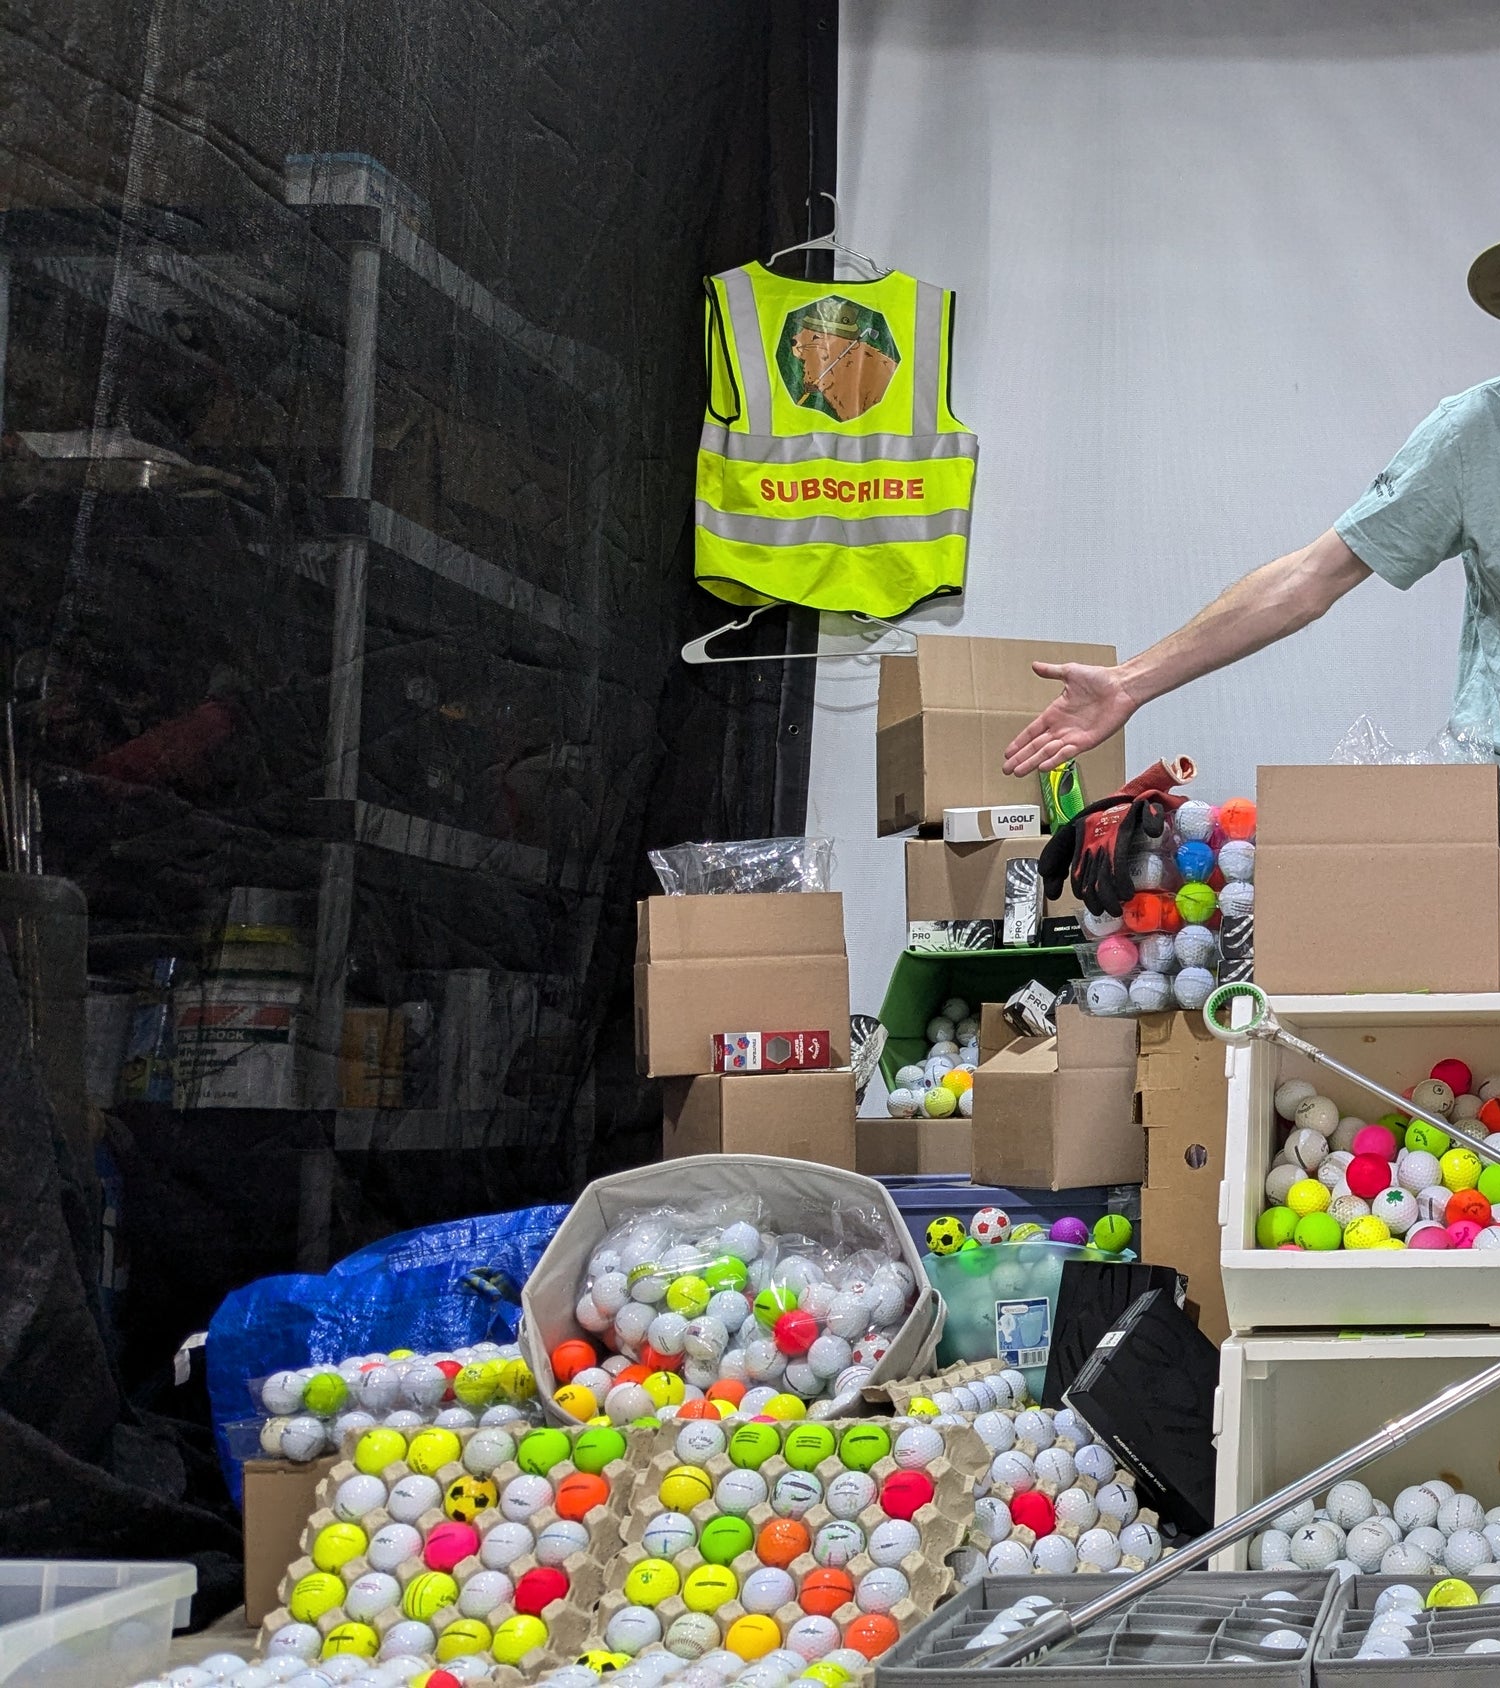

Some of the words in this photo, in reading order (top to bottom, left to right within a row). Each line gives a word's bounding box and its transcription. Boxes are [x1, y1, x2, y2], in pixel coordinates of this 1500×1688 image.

[761, 477, 925, 503] SUBSCRIBE
[912, 932, 931, 940] PRO
[1015, 920, 1023, 939] PRO
[1027, 994, 1048, 1011] PRO
